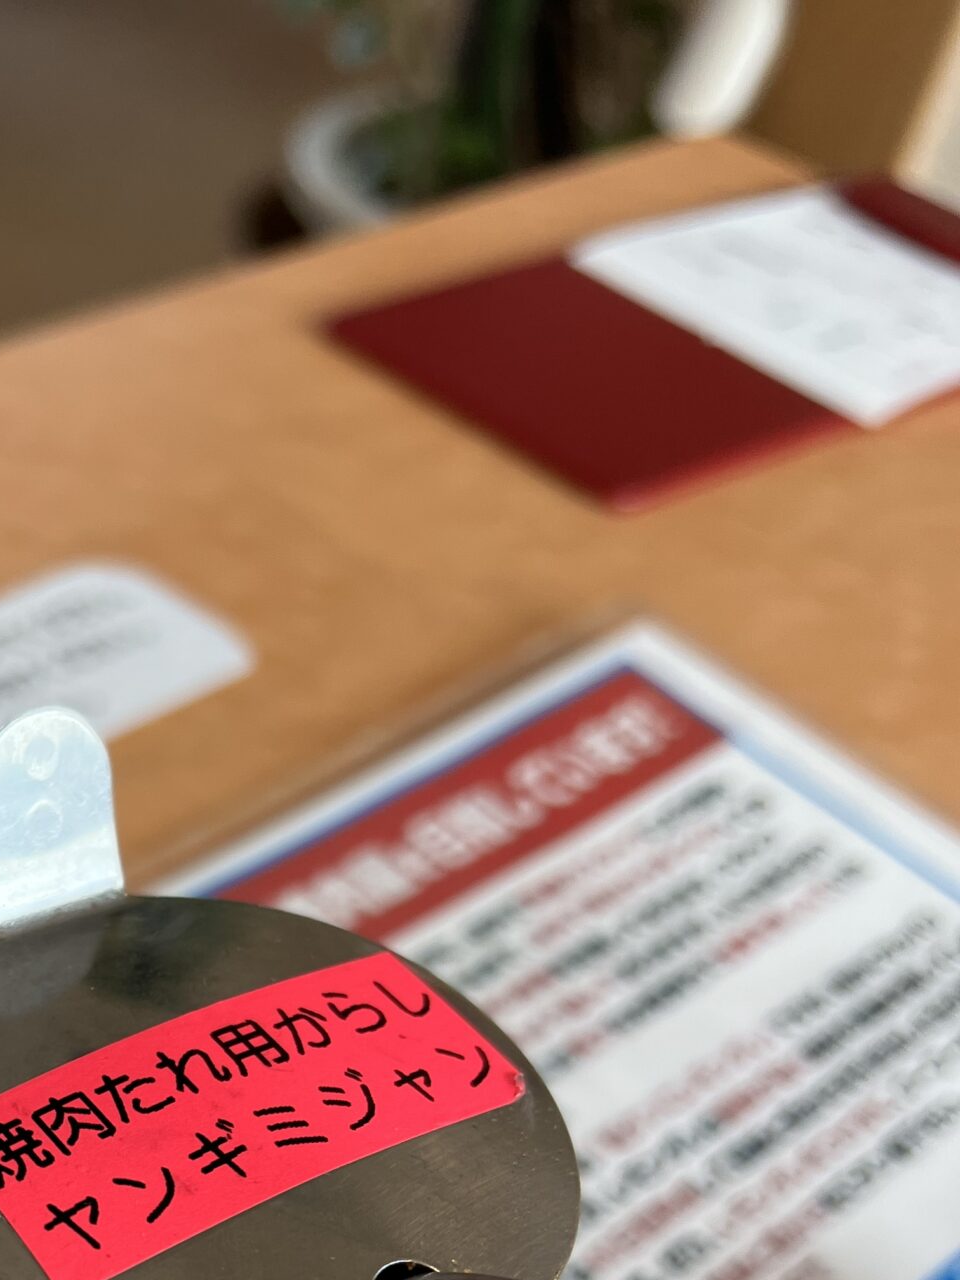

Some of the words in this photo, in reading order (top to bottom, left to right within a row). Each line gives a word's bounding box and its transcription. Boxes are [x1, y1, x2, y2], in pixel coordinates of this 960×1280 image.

[43, 1043, 492, 1250] ヤンギミジャン
